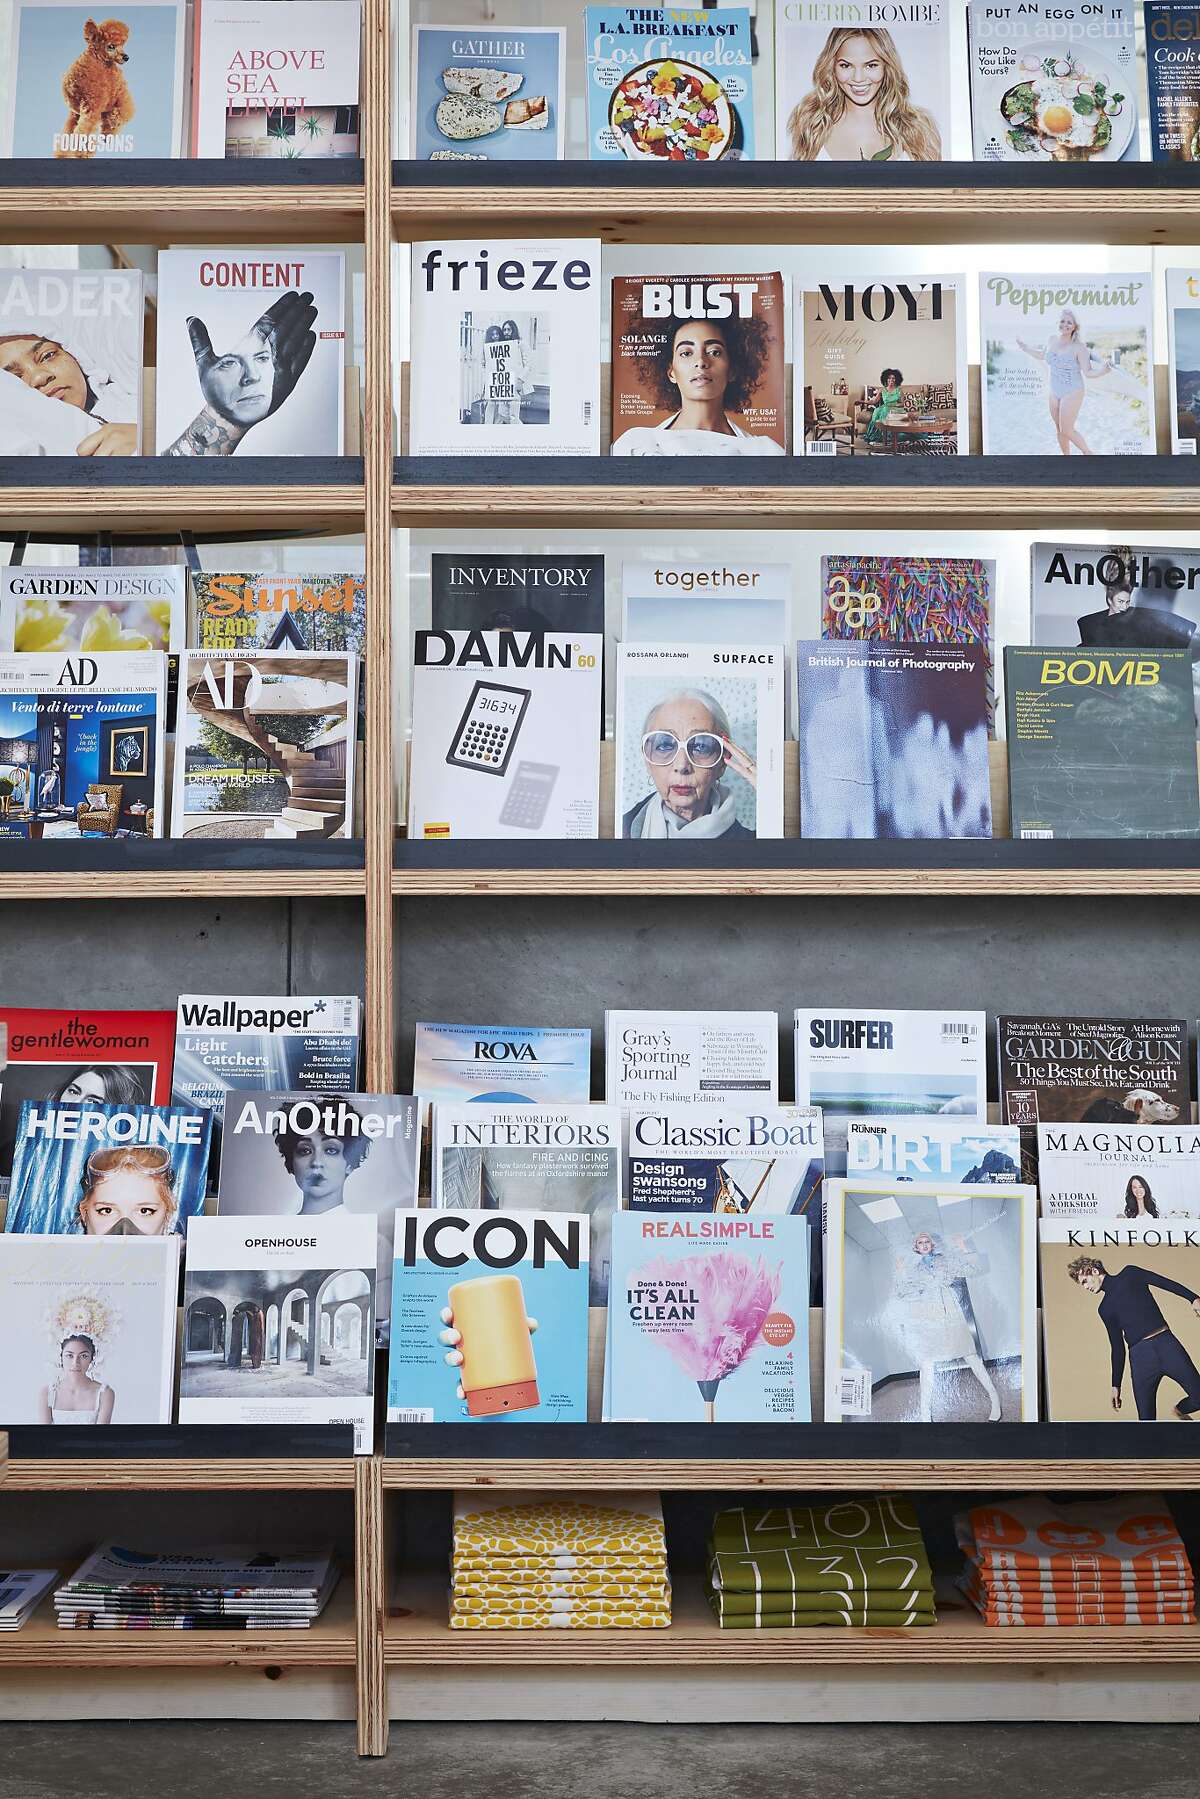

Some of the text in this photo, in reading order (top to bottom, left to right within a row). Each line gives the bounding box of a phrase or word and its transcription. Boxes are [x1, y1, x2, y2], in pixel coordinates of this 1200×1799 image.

[626, 9, 710, 23] THE NEW
[784, 4, 941, 23] CHERRY BOMBE
[986, 3, 1123, 19] PUT AN EGG ON IT
[600, 22, 739, 36] L.A. BREAKFAST
[975, 13, 1134, 42] bon appétit
[452, 39, 526, 57] GATHER
[586, 33, 752, 67] Los Angeles
[978, 47, 1017, 56] How Do
[1154, 48, 1195, 63] Cook
[228, 50, 326, 71] ABOVE
[979, 56, 1016, 66] You Like
[979, 66, 1009, 76] Yours?
[226, 74, 279, 94] SEA
[226, 96, 309, 118] LEVEL
[200, 261, 305, 288] CONTENT
[421, 249, 591, 292] frieze
[642, 283, 758, 319] BUST
[986, 276, 1144, 315] Peppermint
[621, 334, 668, 344] SOLANGE
[489, 344, 511, 358] WAR
[496, 359, 506, 372] IS
[492, 373, 511, 385] FOR
[489, 385, 515, 398] EVER!
[449, 567, 592, 587] INVENTORY
[654, 568, 761, 591] together
[1044, 553, 1200, 590] AnOther
[9, 578, 177, 596] GARDEN DESIGN
[207, 574, 366, 616] Sunset
[203, 617, 257, 637] READY
[577, 655, 596, 668] 60
[627, 651, 659, 659] ROSSANA
[713, 653, 775, 664] SURFACE
[57, 657, 99, 687] AD
[808, 656, 844, 668] British
[846, 656, 886, 668] Journal
[888, 658, 900, 668] of
[902, 658, 975, 672] Photography
[1040, 659, 1161, 686] BOMB
[11, 700, 143, 713] Vento di terre lontane
[478, 697, 517, 715] 31634
[188, 774, 276, 784] DREAM HOUSES
[67, 1016, 98, 1036] the
[809, 1018, 894, 1050] SURFER
[1006, 1021, 1042, 1031] Savannah,
[1066, 1023, 1126, 1033] The Untold Story
[1164, 1024, 1181, 1032] with
[11, 1029, 150, 1052] gentlewoman
[184, 1037, 229, 1054] Light
[318, 1038, 340, 1046] Dhabi
[622, 1028, 671, 1047] Gray's
[474, 1041, 538, 1061] ROVA
[1005, 1036, 1111, 1061] GARDEN
[1126, 1039, 1183, 1061] GUN
[203, 1052, 270, 1066] catchers
[312, 1055, 333, 1063] Brute
[622, 1047, 691, 1068] Sporting
[621, 1064, 678, 1082] Journal
[1011, 1062, 1177, 1081] The Best of the South
[1031, 1079, 1056, 1087] Things
[1070, 1079, 1090, 1087] Must
[623, 1090, 725, 1104] The Fly Fishing Edition
[1016, 1102, 1030, 1113] 10
[233, 1100, 413, 1140] AnOther Magazine
[492, 1115, 570, 1123] THE WORLD OF
[1010, 1112, 1037, 1120] YEARS
[27, 1108, 204, 1145] HEROINE
[635, 1116, 818, 1147] Classic Boat
[851, 1124, 887, 1134] RUNNER
[451, 1124, 610, 1146] INTERIORS
[532, 1152, 609, 1162] FIRE AND ICING
[848, 1134, 963, 1173] DIRT
[1100, 1153, 1155, 1163] JOURNAL
[512, 1162, 538, 1170] fantasy
[539, 1162, 579, 1170] plasterwork
[546, 1169, 586, 1177] Oxfordshire
[633, 1161, 685, 1177] Design
[632, 1177, 707, 1190] swansong
[648, 1195, 670, 1203] yacht
[652, 1188, 696, 1196] Shepherd's
[1049, 1192, 1098, 1201] A FLORAL
[642, 1221, 775, 1239] REAL SIMPLE
[244, 1237, 318, 1249] OPENHOUSE
[403, 1216, 580, 1270] ICON
[1067, 1230, 1200, 1248] KINFOLK
[637, 1280, 657, 1288] Done
[665, 1280, 688, 1288] Done!
[627, 1289, 700, 1304] IT'S ALL
[629, 1306, 695, 1321] CLEAN
